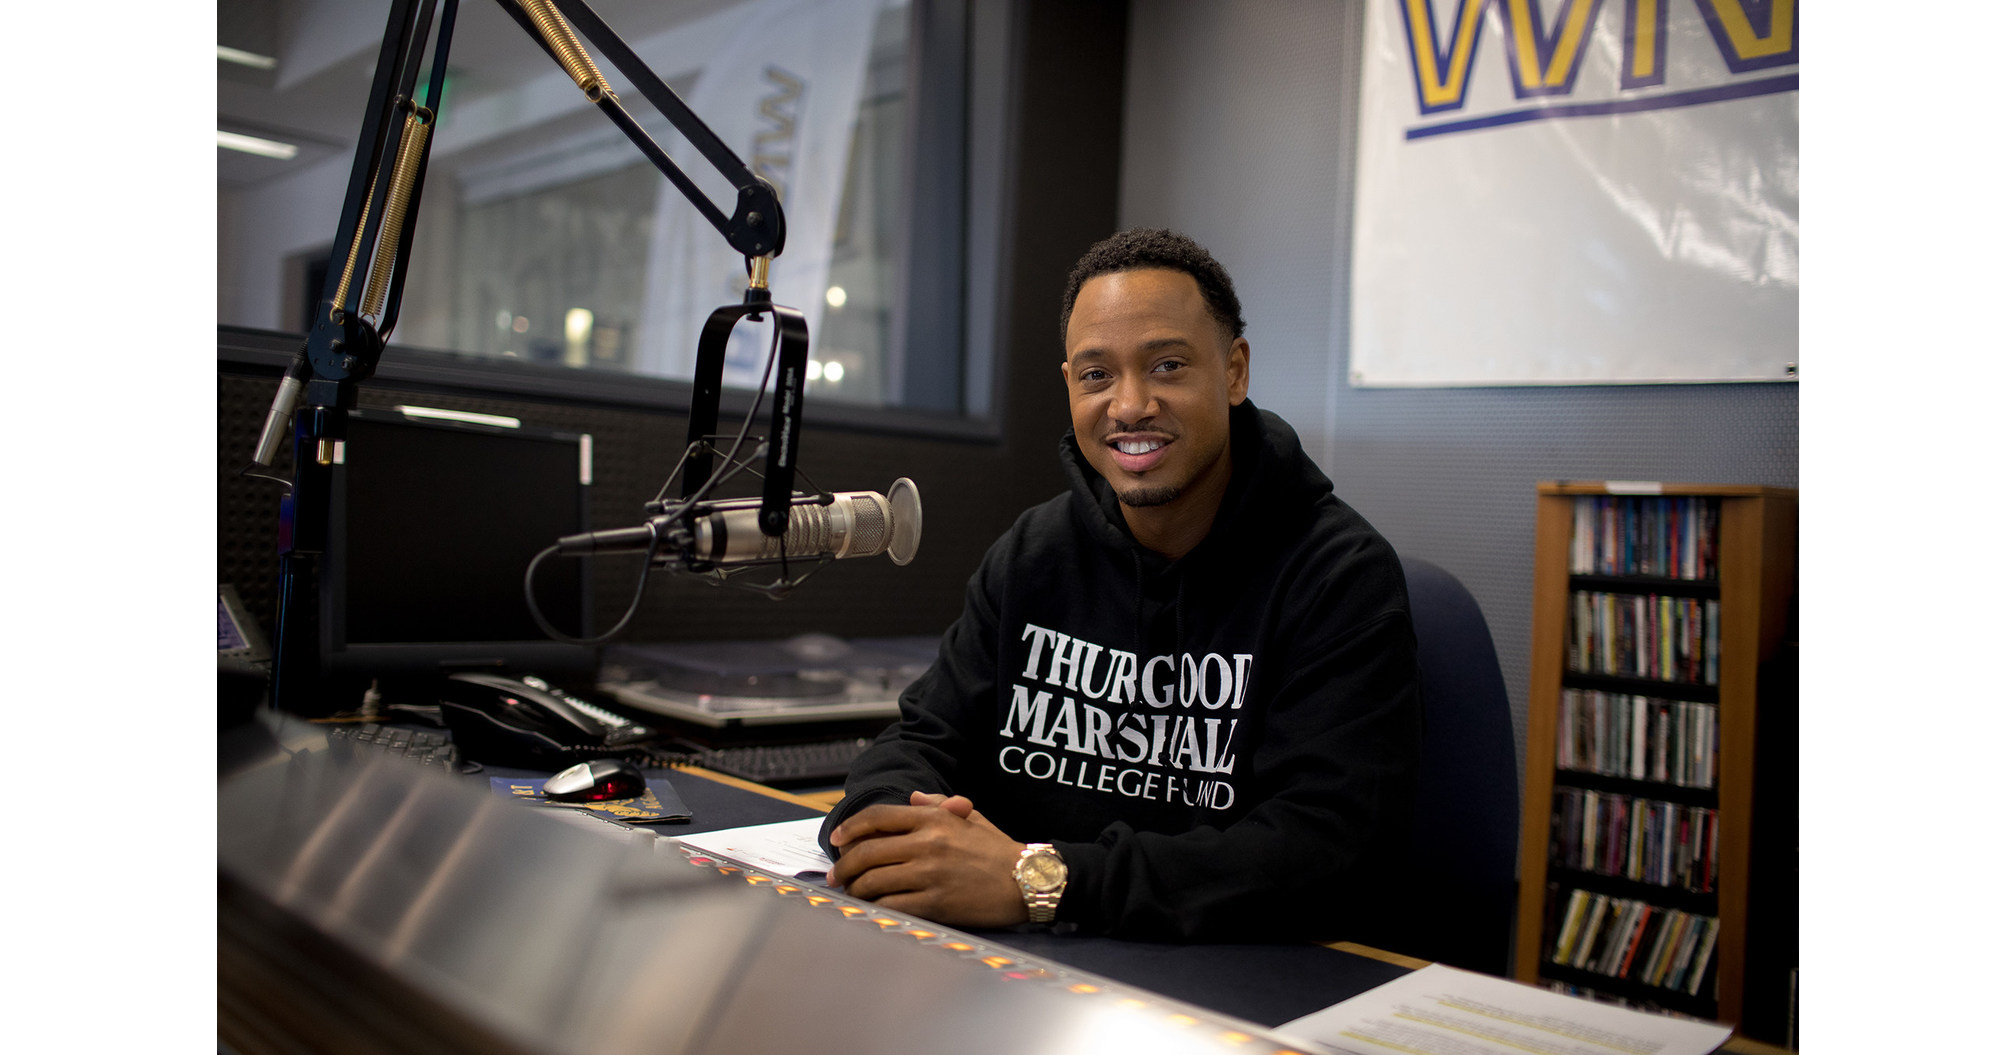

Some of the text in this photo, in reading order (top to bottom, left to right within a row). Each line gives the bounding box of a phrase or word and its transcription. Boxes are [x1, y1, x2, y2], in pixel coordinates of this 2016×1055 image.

[1022, 623, 1253, 709] THURGOOD
[1000, 684, 1238, 775] MARSHALL
[999, 746, 1235, 810] COLLEGE FUND
